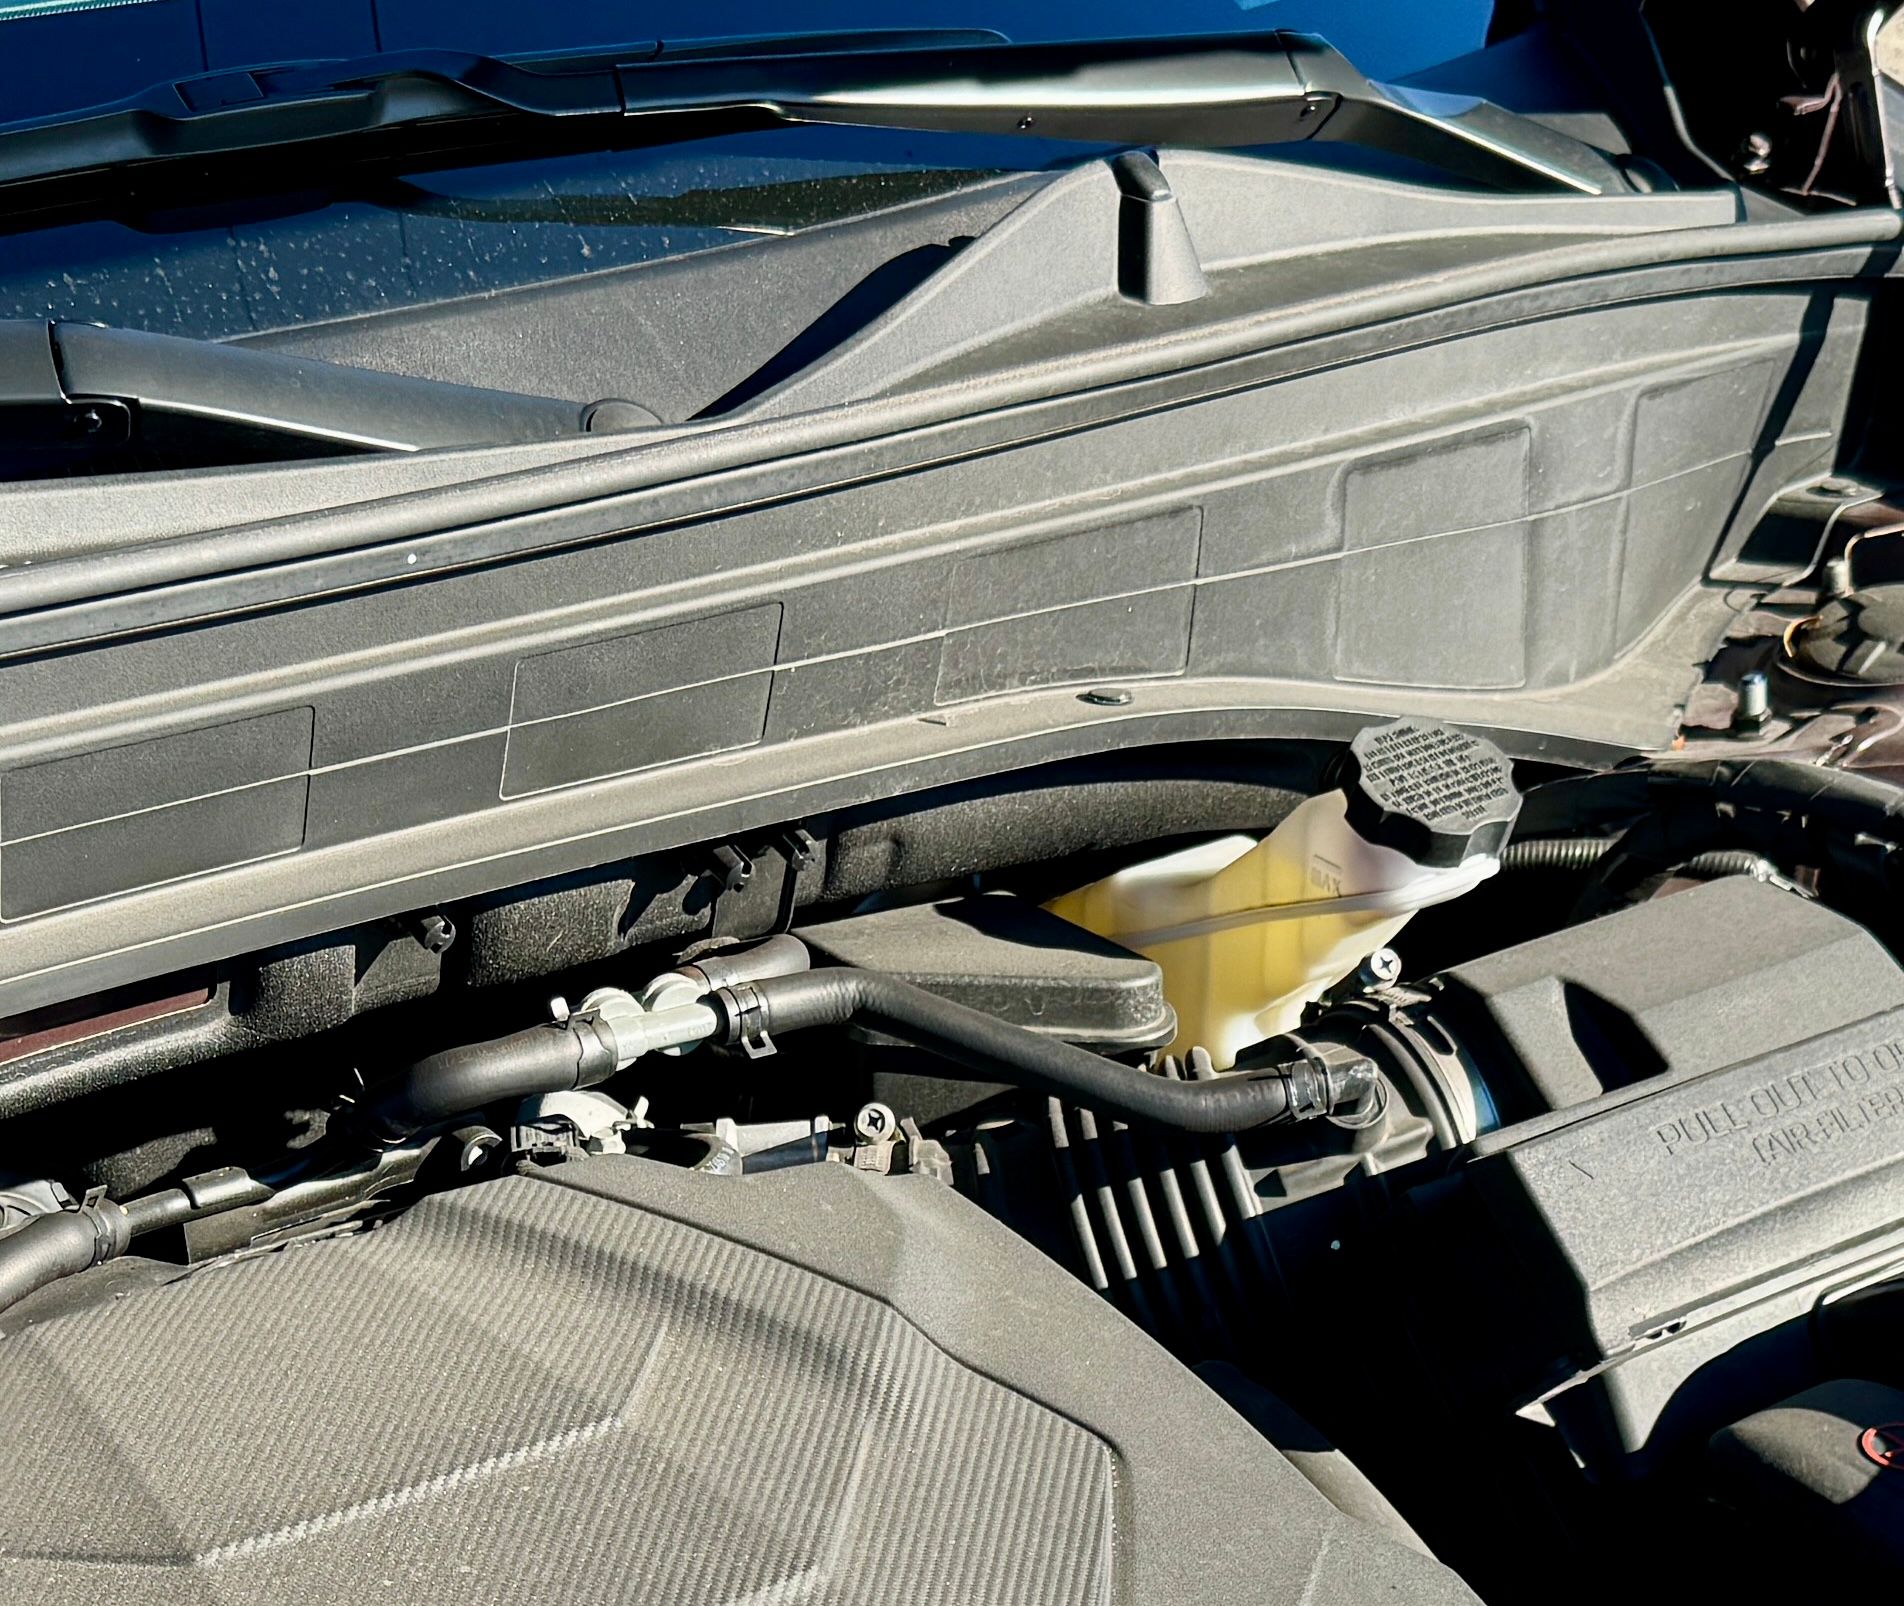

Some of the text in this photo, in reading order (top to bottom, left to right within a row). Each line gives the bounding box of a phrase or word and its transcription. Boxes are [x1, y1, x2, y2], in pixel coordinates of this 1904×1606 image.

[1654, 1101, 1749, 1156] PULL
[1750, 1073, 1819, 1119] OUT
[1819, 1053, 1872, 1090] TO
